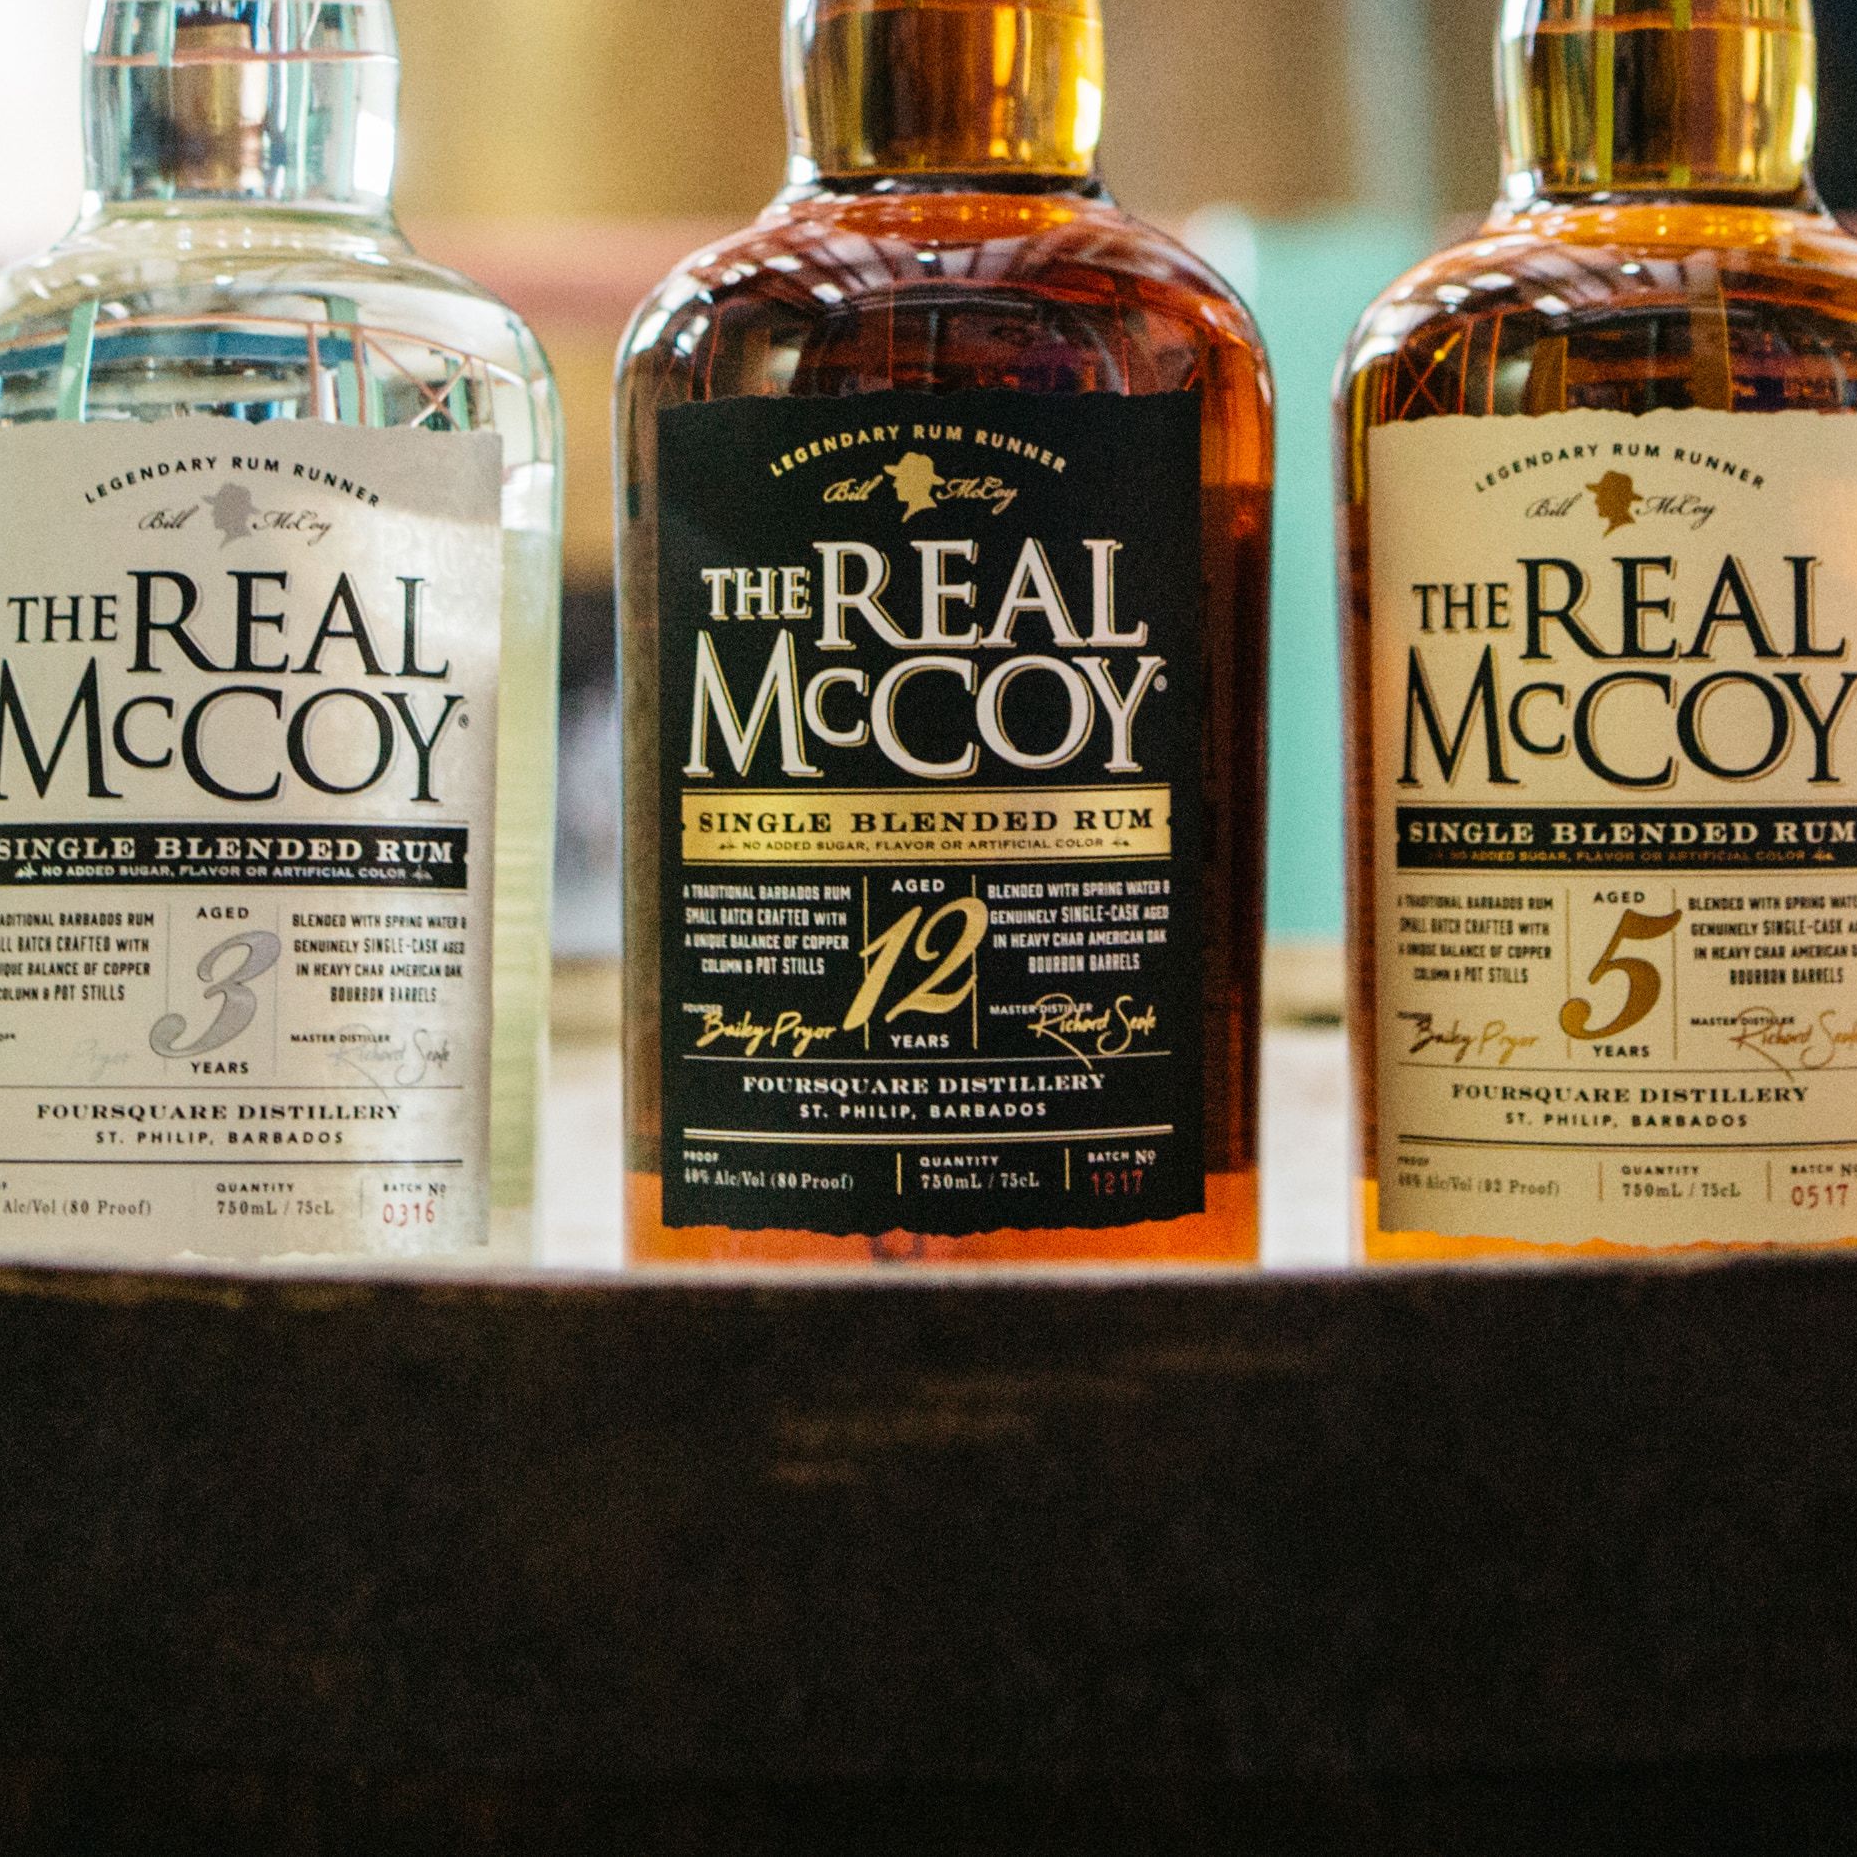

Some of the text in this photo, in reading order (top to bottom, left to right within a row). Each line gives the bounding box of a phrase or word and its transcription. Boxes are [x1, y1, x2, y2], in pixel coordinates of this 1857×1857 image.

[770, 425, 1067, 478] LEGENDARY RUM RUNNER
[1474, 443, 1766, 493] LEGENDARY RUM RUNNER
[84, 455, 380, 508] LEGENDARY RUM RUNNER
[823, 475, 1018, 515] Bill McCoy
[1526, 493, 1716, 527] Bill McCoy
[138, 505, 332, 546] Bill McCoy
[702, 537, 1148, 649] THE REAL
[1412, 554, 1847, 661] THE REAL
[8, 570, 451, 681] THE REAL
[699, 808, 1153, 833] SINGLE BLENDED RUM
[1409, 821, 1856, 843] SINGLE BLENDED RUM
[155, 837, 362, 861] BLENDED
[376, 839, 453, 864] RUM
[743, 838, 1103, 852] NO ADDED SUGAR, FLAVOR OR ARTIFICIAL COLOR
[42, 865, 406, 879] NO ADDED SUGAR, FLAVOR OR ARTIFICIAL COLOR
[824, 885, 851, 900] RUM
[891, 879, 945, 893] AGED
[987, 882, 1123, 899] BLENDED WITH SPRING
[1594, 892, 1645, 903] AGED
[59, 914, 122, 926] BARBADOS
[128, 914, 154, 926] RUM
[197, 907, 248, 919] AGED
[293, 914, 459, 928] BLENDED WITH SPRING WATER
[757, 909, 846, 926] CRAFTED WITH
[990, 905, 1139, 924] GENUINELY SINGLE-CASK
[18, 936, 51, 952] BATCH
[57, 936, 110, 952] CRAFTED
[116, 938, 149, 952] WITH
[295, 938, 437, 954] GENUINELY SINGLE-CASK
[803, 935, 848, 950] COPPER
[993, 931, 1144, 948] IN HEAVY CHAR AMERICAN
[28, 962, 150, 976] BALANCE OF COPPER
[297, 963, 440, 977] IN HEAVY CHAR AMERICAN
[756, 957, 825, 975] POT STILLS
[843, 897, 989, 1031] 12
[1029, 954, 1140, 973] BOURBON BARRELS
[1559, 909, 1683, 1039] 5
[55, 985, 124, 1001] POT STILLS
[149, 930, 281, 1059] 3
[331, 986, 436, 1002] BOURBON BARRELS
[990, 1005, 1036, 1015] MASTER
[291, 1034, 335, 1042] MASTER
[891, 1035, 949, 1049] YEARS
[1593, 1045, 1649, 1057] YEARS
[191, 1062, 249, 1074] YEARS
[743, 1074, 1105, 1097] FOURSQUARE DISTILLERY
[1452, 1083, 1809, 1104] FOURSQUARE DISTILLERY
[37, 1104, 401, 1121] FOURSQUARE DISTILLERY
[799, 1103, 1046, 1119] ST. PHILIP, BARBADOS
[1506, 1112, 1747, 1128] ST. PHILIP, BARBADOS
[97, 1132, 343, 1145] ST. PHILIP, BARBADOS
[920, 1155, 999, 1167] QUANTITY
[1088, 1152, 1129, 1163] BATCH
[1622, 1166, 1699, 1175] QUANTITY
[1791, 1165, 1832, 1174] BATCH
[217, 1183, 294, 1193] QUANTITY
[383, 1184, 421, 1192] BATCH
[770, 1172, 853, 1191] (80 Proof)
[921, 1172, 1040, 1189] 750mL 75cL
[1091, 1170, 1143, 1195] 1217
[1622, 1183, 1741, 1197] 750mL 75cL
[1792, 1184, 1848, 1208] 0517
[3, 1200, 151, 1215] Alc/Vol (80 Proof)
[217, 1201, 334, 1215] 750mL 75cL
